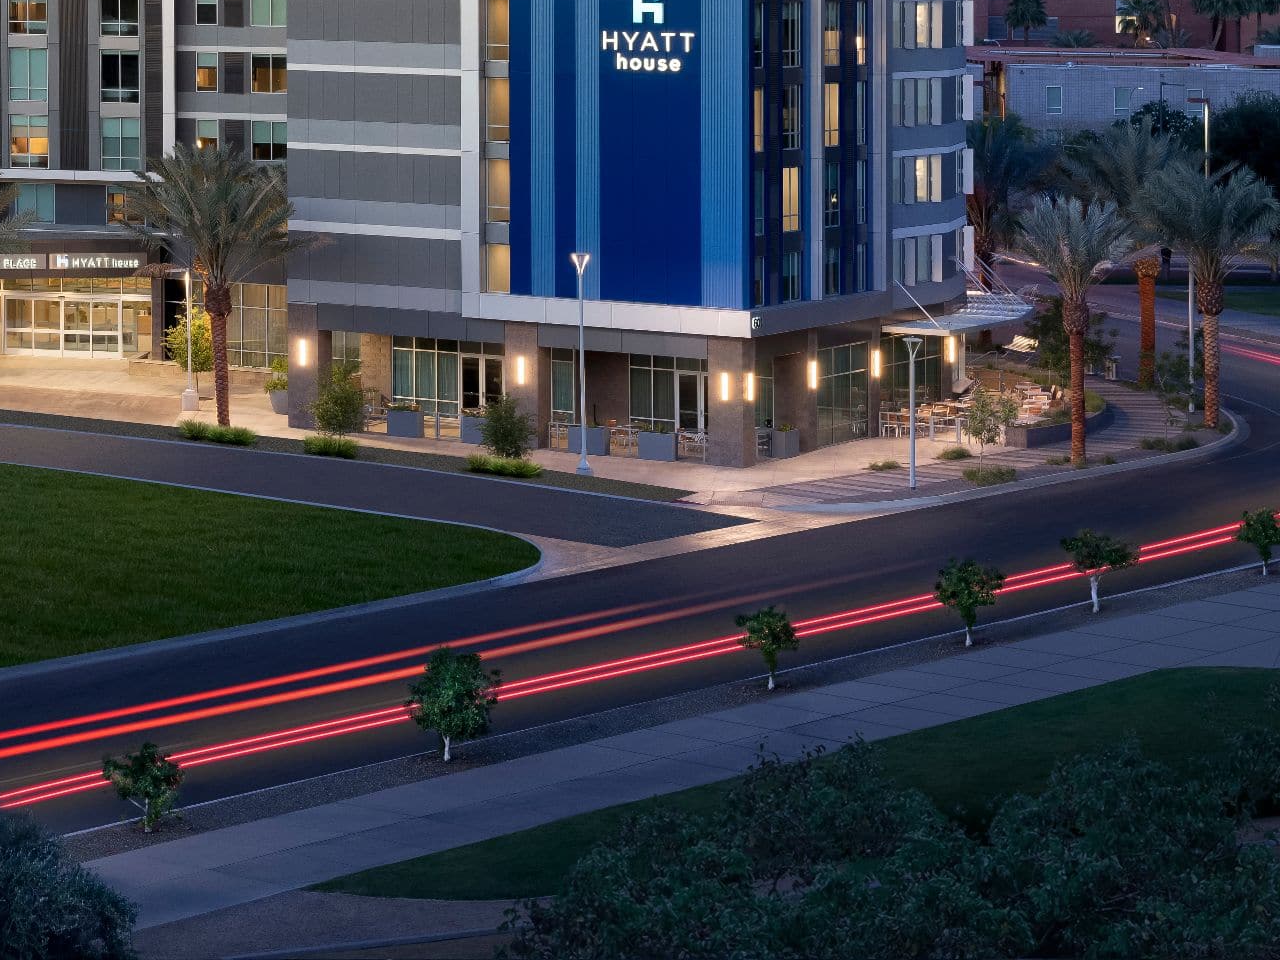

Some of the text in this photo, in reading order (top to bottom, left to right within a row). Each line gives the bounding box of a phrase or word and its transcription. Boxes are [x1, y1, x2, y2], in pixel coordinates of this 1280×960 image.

[602, 30, 696, 53] HYATT
[616, 52, 682, 72] house
[3, 258, 37, 269] PLACE
[72, 257, 110, 269] HYATT
[112, 258, 140, 269] house
